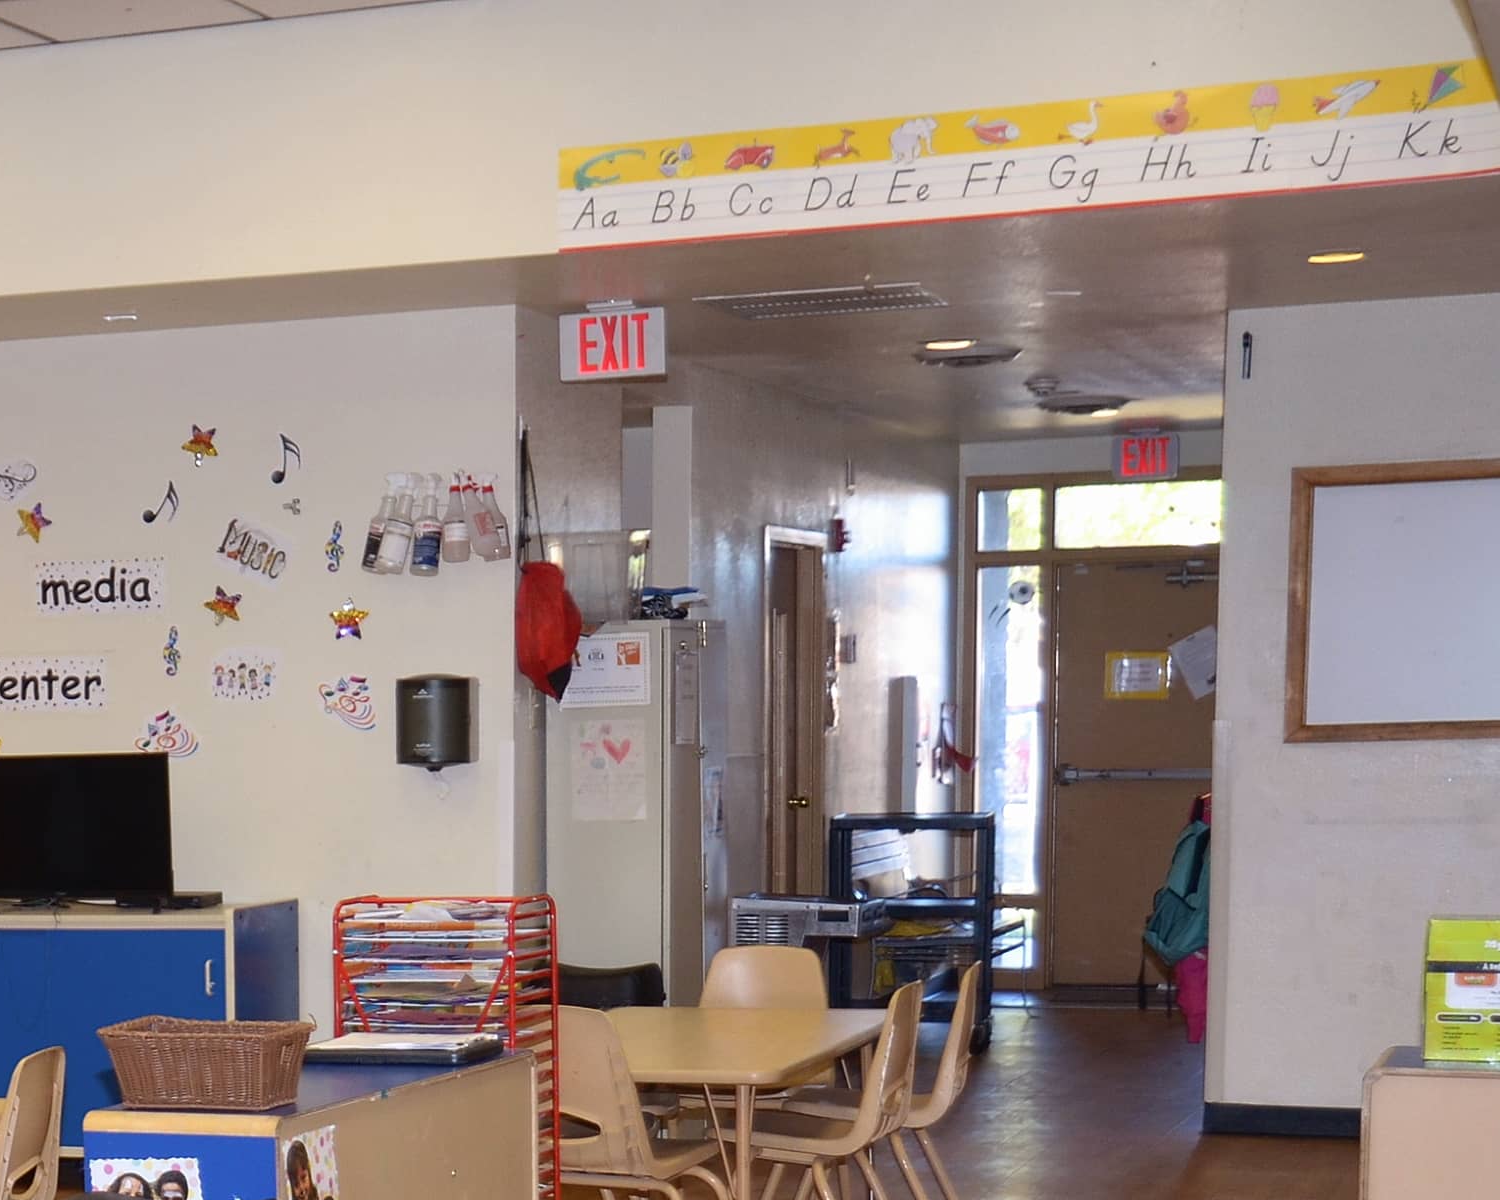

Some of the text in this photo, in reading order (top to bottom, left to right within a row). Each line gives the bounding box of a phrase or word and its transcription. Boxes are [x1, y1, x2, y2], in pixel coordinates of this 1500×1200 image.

[573, 118, 1463, 231] Aa Bb Cc Dd Ee Ff Gg Hh Ii Jj Kk
[579, 312, 649, 373] EXIT
[1122, 436, 1170, 476] EXIT
[40, 566, 152, 607] media
